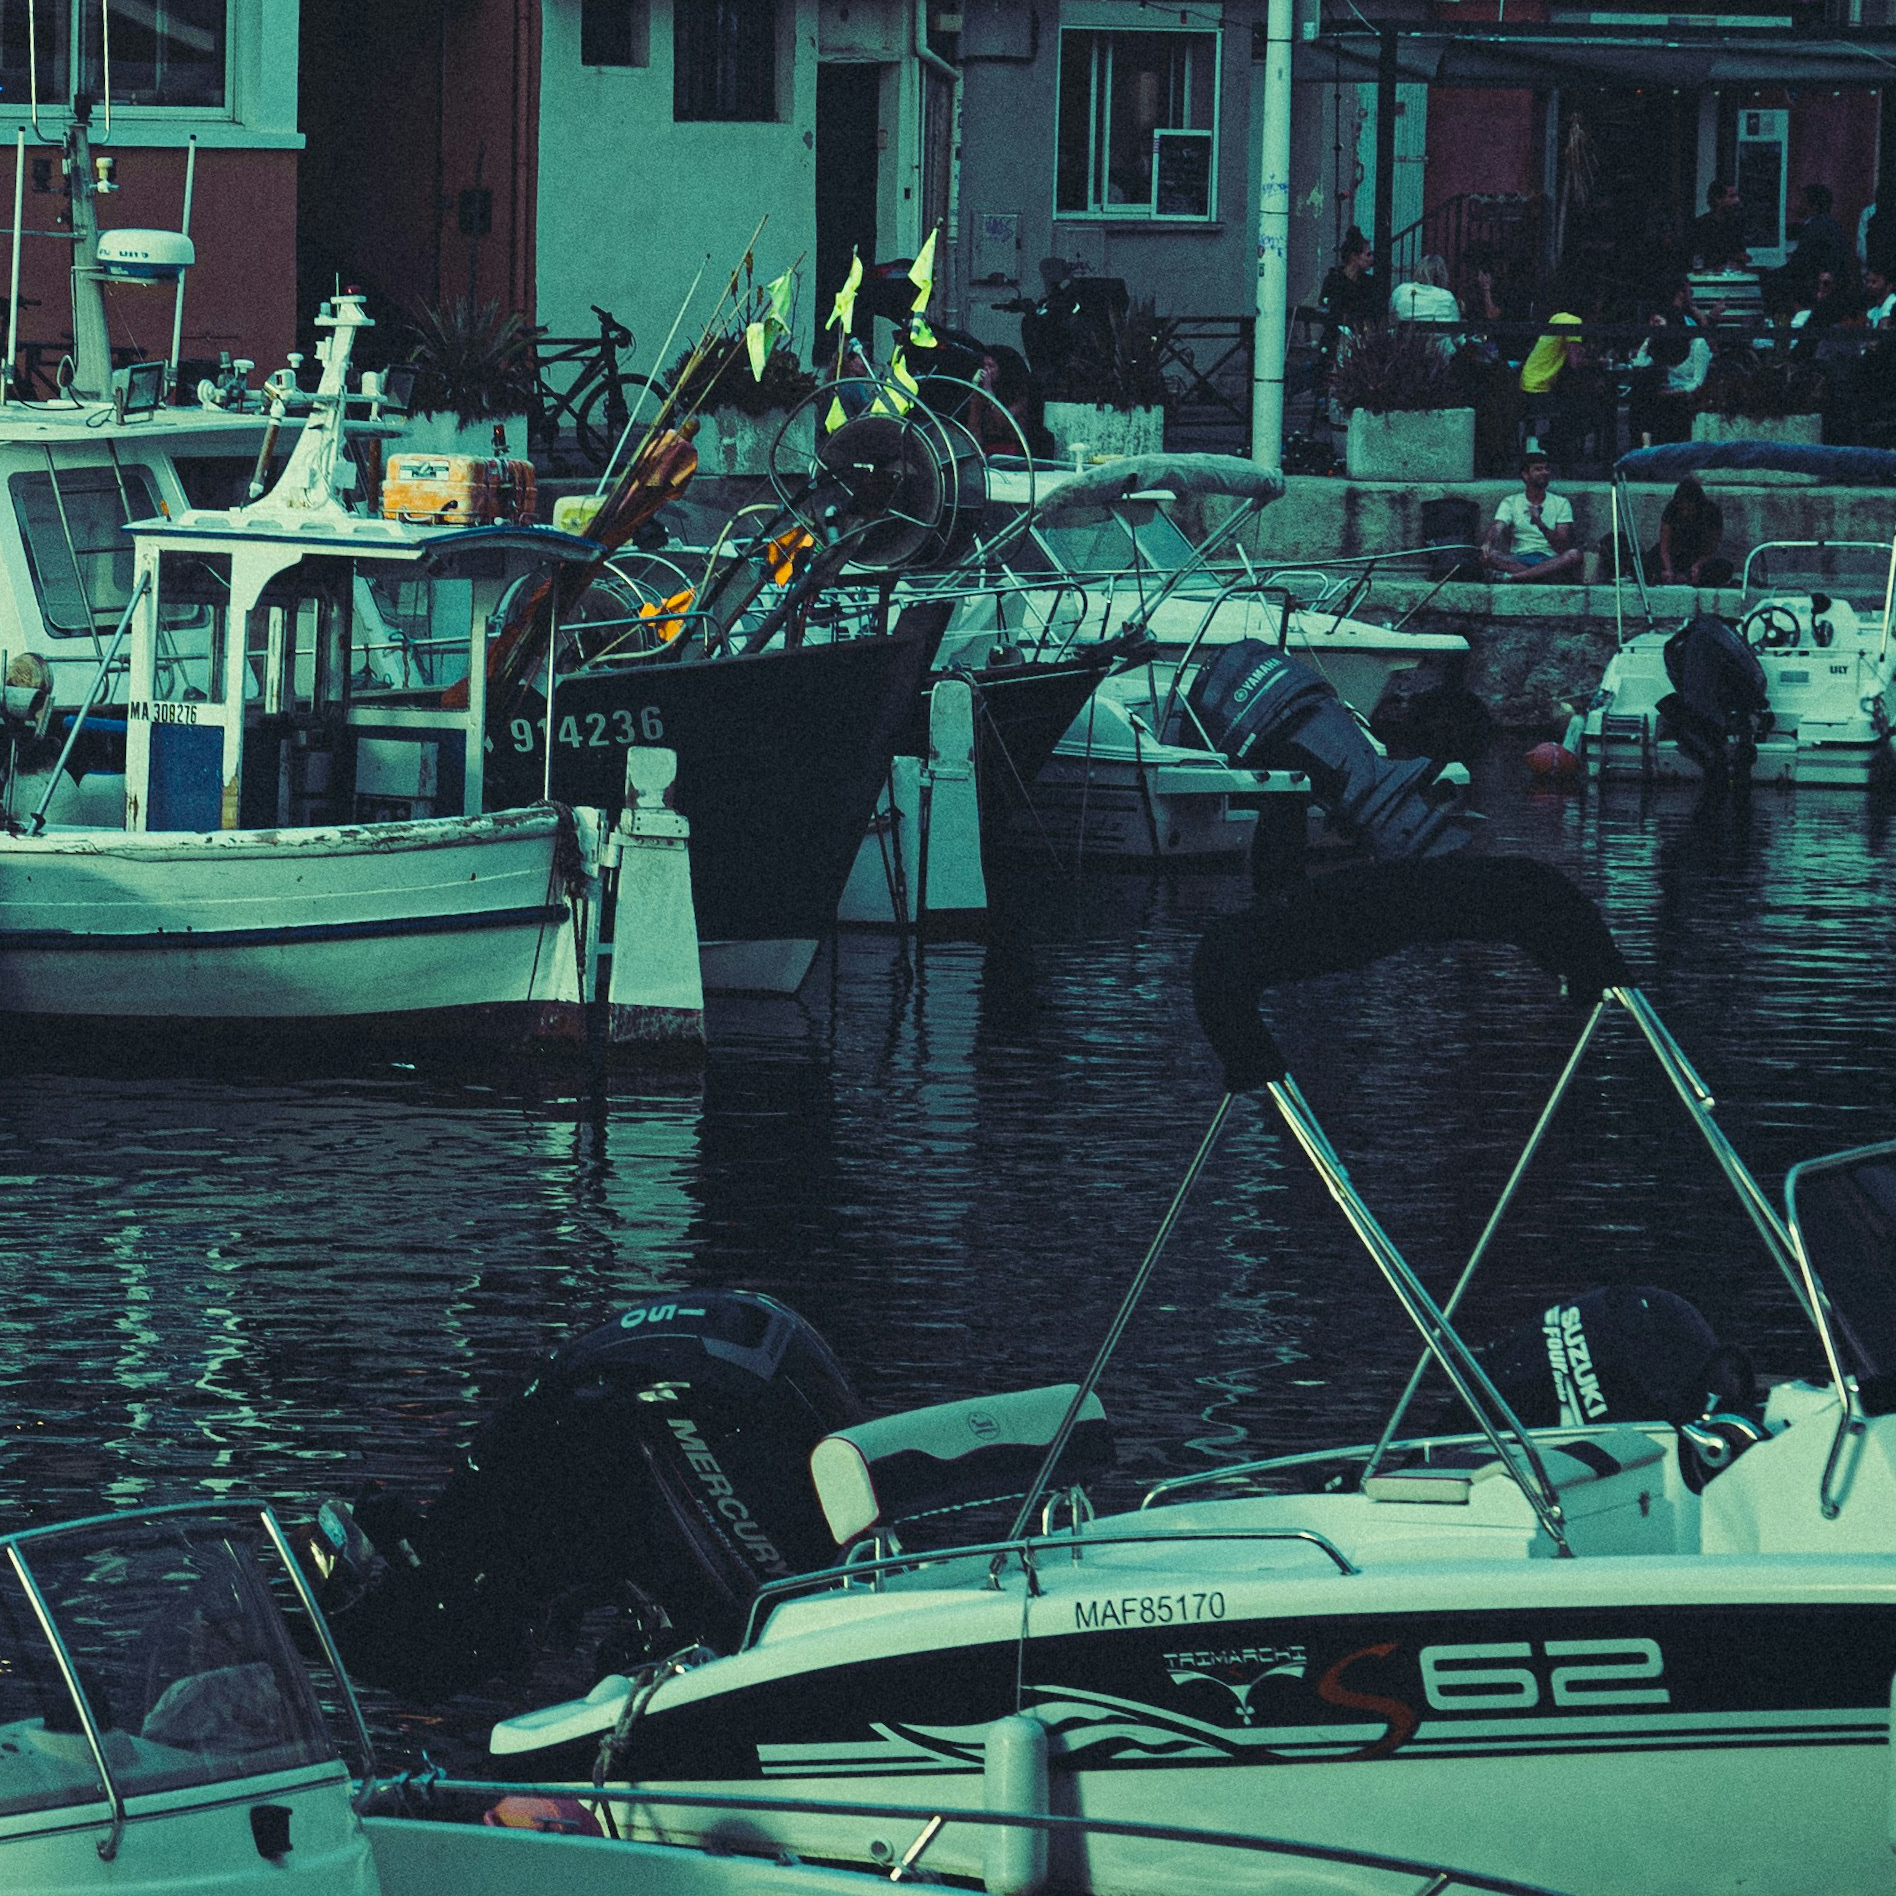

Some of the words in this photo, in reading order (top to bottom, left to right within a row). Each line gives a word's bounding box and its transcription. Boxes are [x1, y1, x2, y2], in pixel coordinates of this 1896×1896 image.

[1242, 657, 1283, 691] YAMAHA
[130, 701, 149, 721] MA
[1560, 1305, 1609, 1419] SUZUKI
[666, 1418, 797, 1577] MERCURY
[1074, 1591, 1227, 1629] MAF85170
[1162, 1645, 1308, 1668] TRIMARCHI
